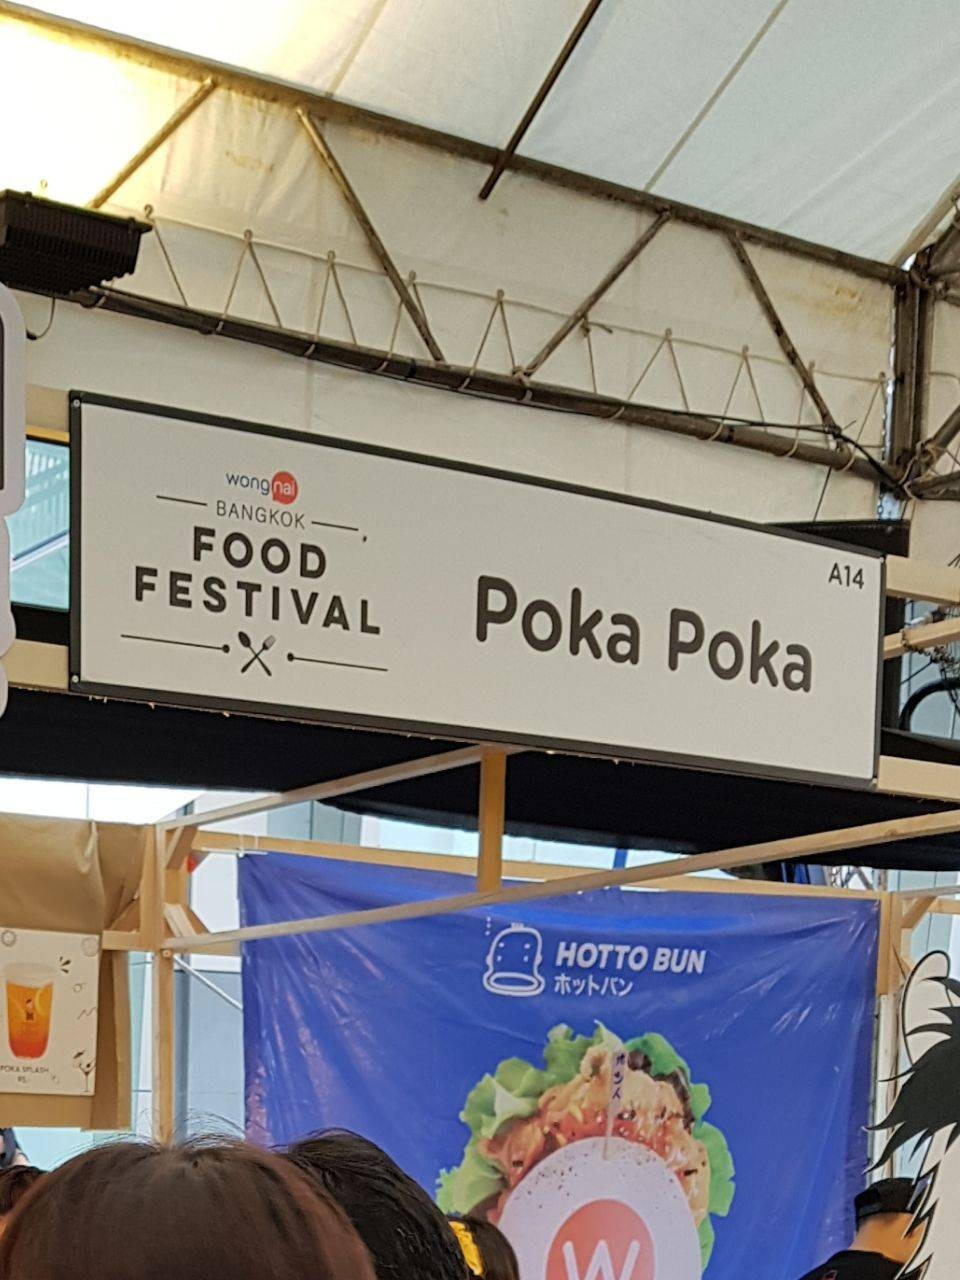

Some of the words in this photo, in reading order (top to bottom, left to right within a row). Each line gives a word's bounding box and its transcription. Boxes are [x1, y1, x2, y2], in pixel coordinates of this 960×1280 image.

[215, 500, 306, 529] BANGKOK
[193, 526, 327, 579] FOOD
[828, 562, 865, 590] A14
[135, 565, 381, 636] FESTIVAL
[476, 575, 640, 666] Poka
[668, 608, 813, 694] Poka
[556, 942, 648, 972] HOTTO
[653, 948, 707, 975] BUN
